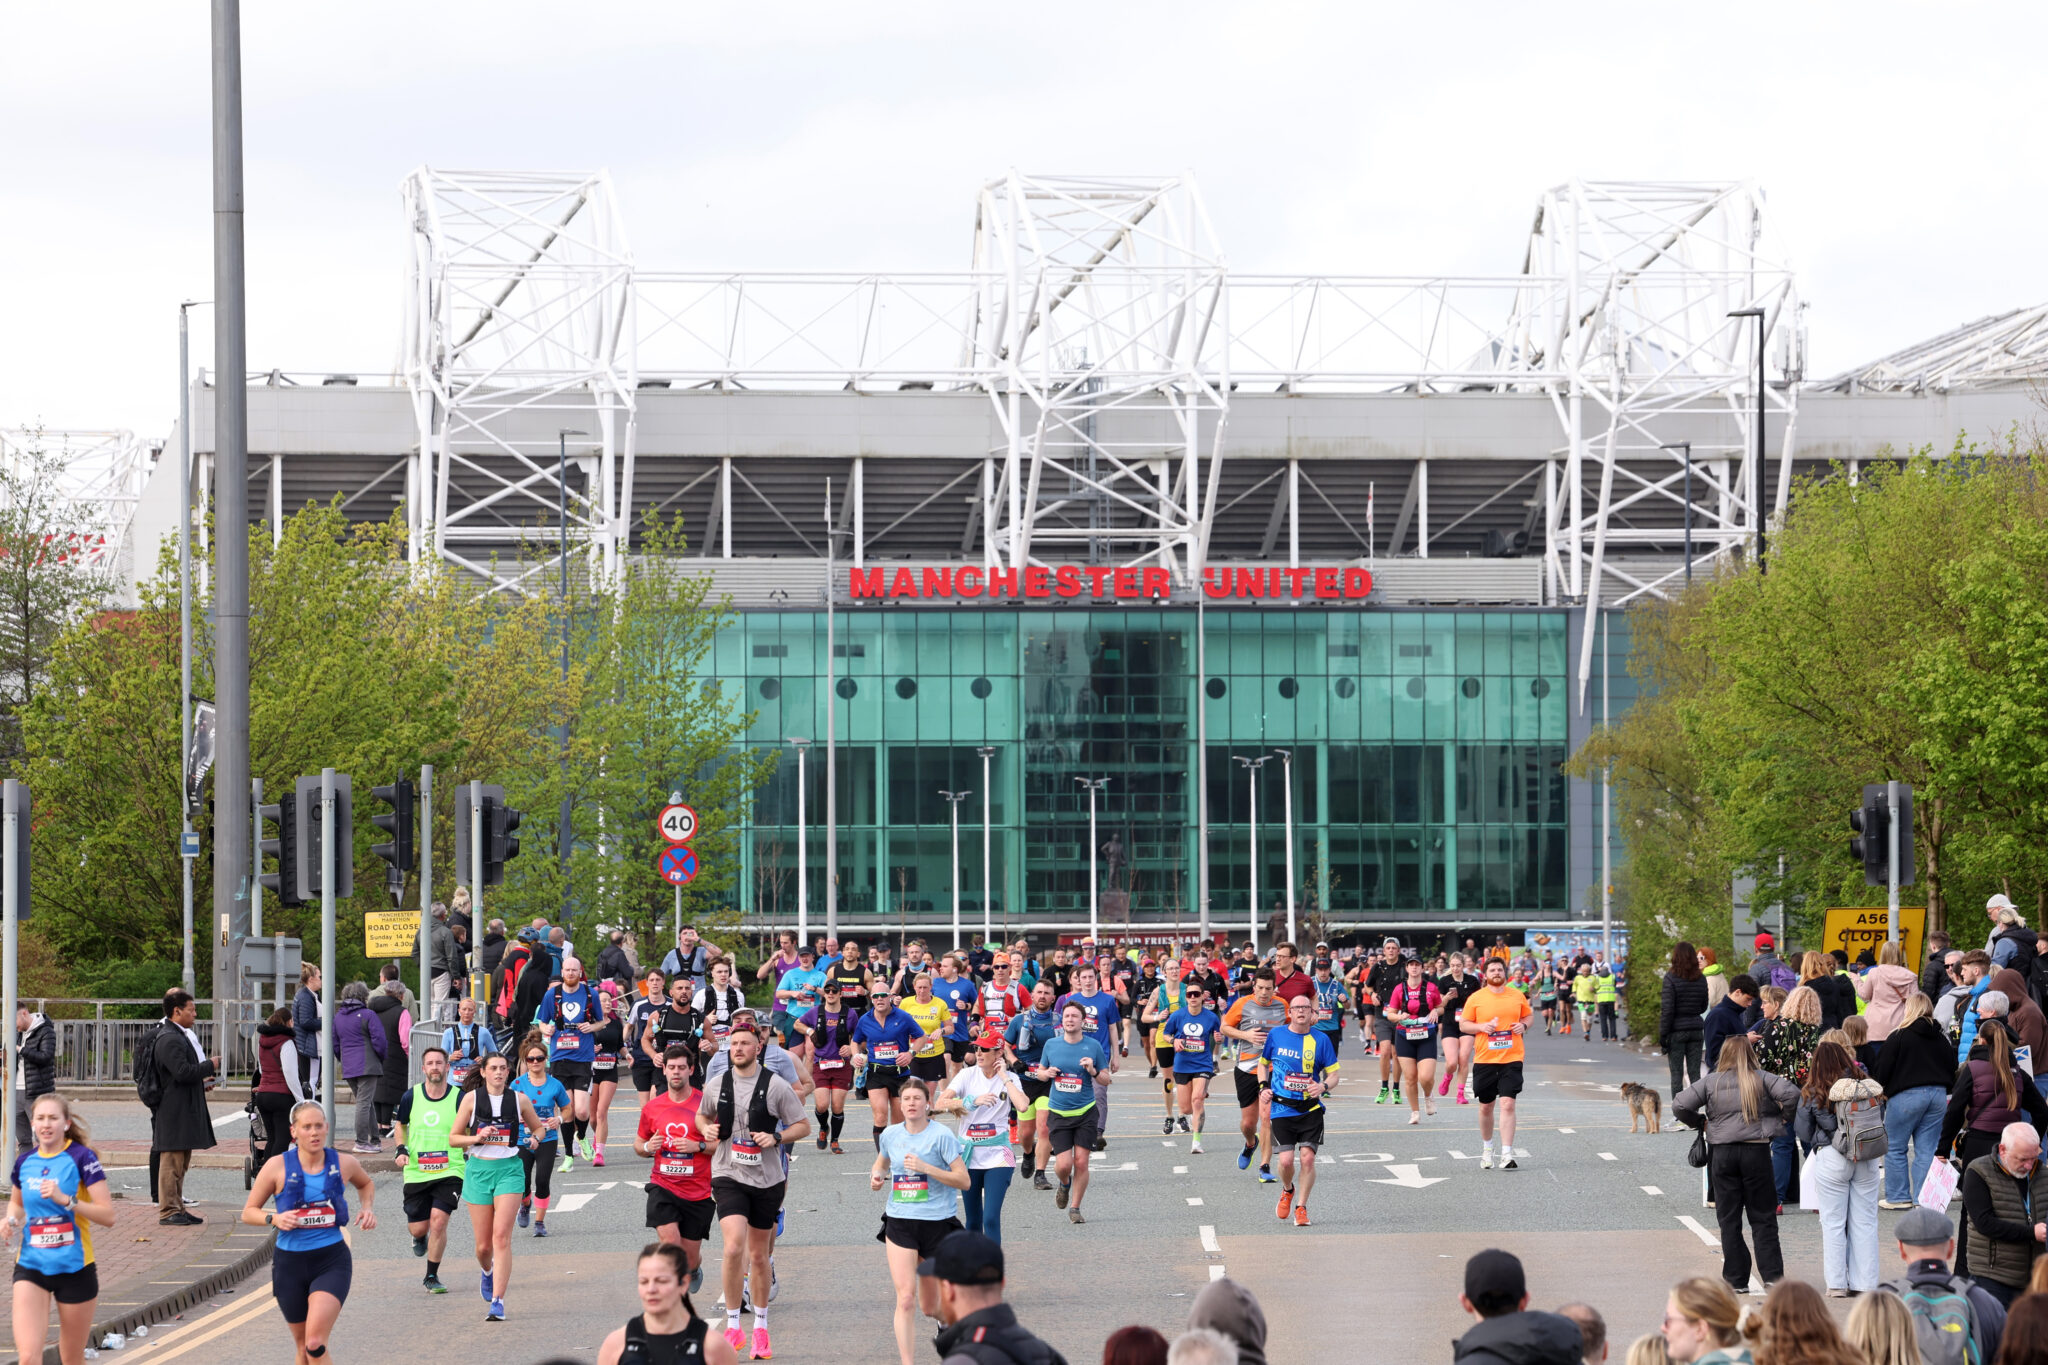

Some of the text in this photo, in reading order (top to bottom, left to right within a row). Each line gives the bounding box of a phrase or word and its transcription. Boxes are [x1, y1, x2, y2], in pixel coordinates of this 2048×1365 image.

[849, 565, 1374, 598] MANCHESTER UNITED
[664, 815, 693, 831] 40
[1856, 913, 1888, 924] A56
[1145, 936, 1175, 946] FRIES
[1338, 947, 1417, 958] MEASRE
[1277, 1047, 1300, 1059] PAUL
[735, 1152, 758, 1161] 30646
[423, 1163, 444, 1171] 25568
[303, 1216, 326, 1225] 31149
